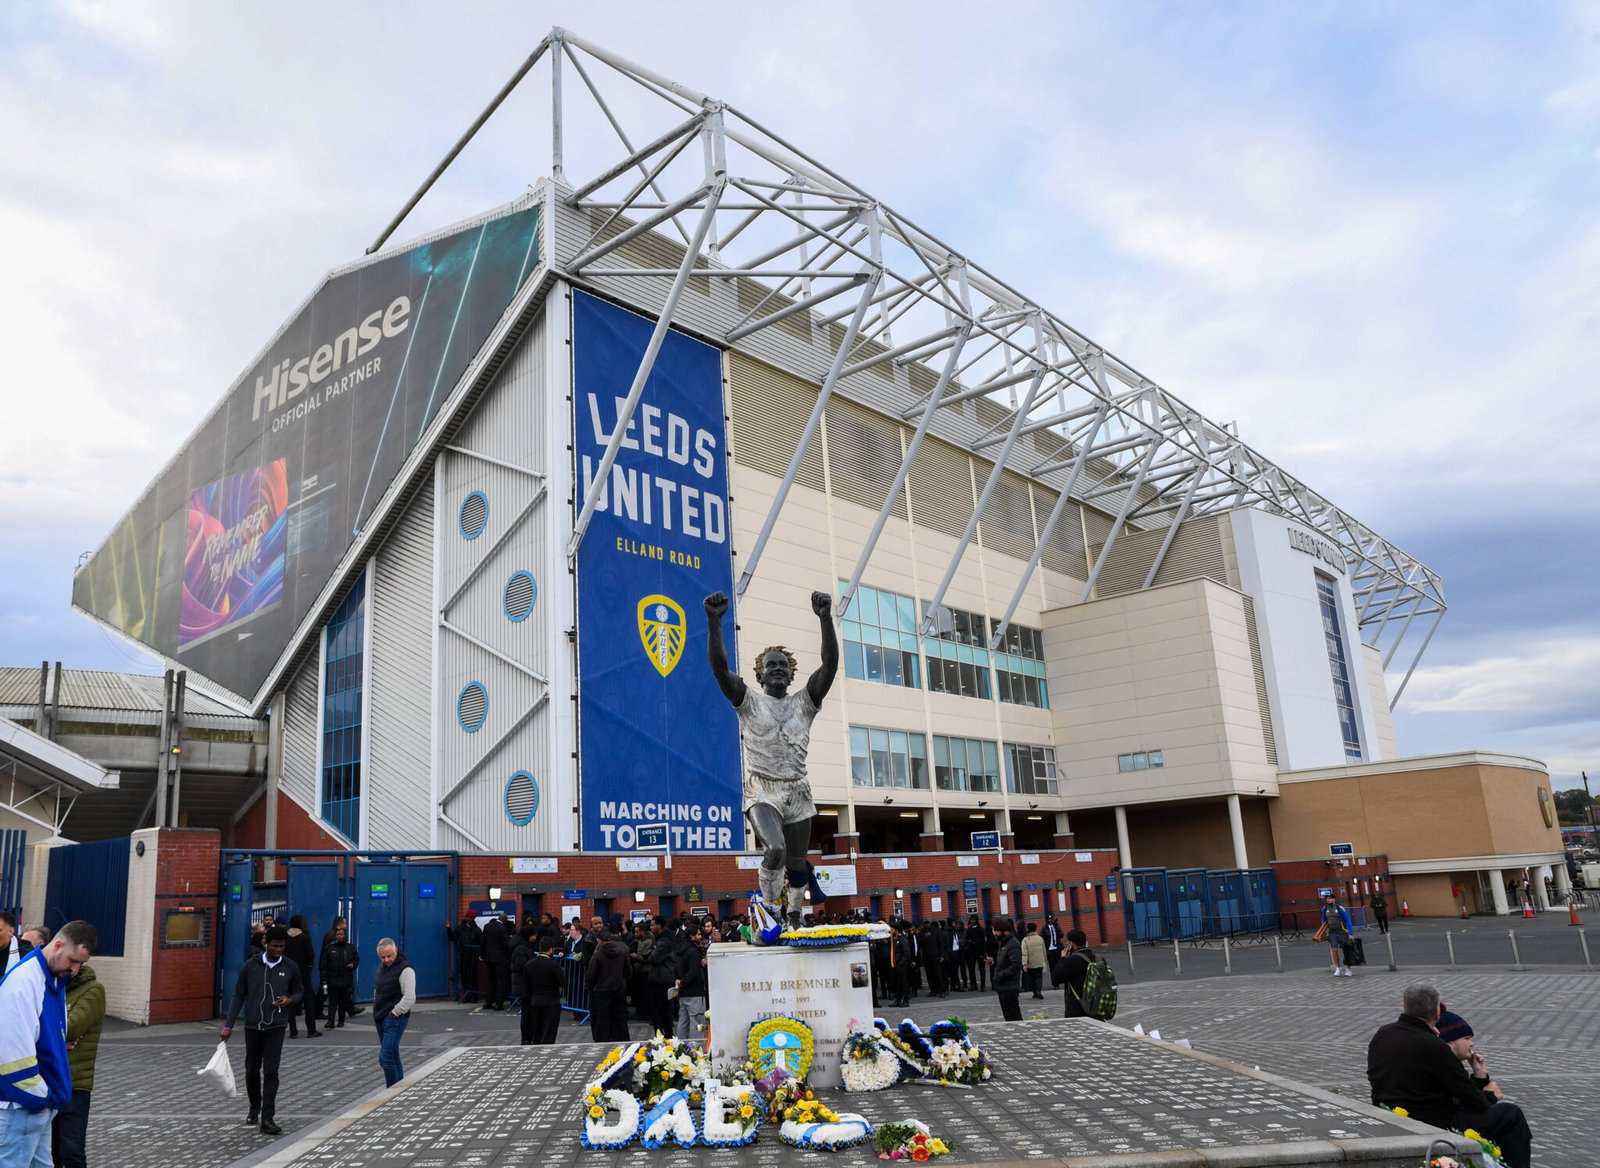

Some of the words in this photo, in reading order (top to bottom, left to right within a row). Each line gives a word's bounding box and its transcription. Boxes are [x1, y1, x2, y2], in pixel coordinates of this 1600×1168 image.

[252, 296, 410, 421] Hisense
[272, 393, 321, 432] OFFICIAL
[326, 357, 381, 401] PARTNER
[588, 393, 716, 478] LEEDS
[582, 455, 725, 544] UNITED
[617, 537, 663, 560] ELLAND
[670, 551, 700, 569] ROAD
[600, 801, 701, 821] MARCHING
[707, 805, 732, 822] ON
[600, 824, 732, 849] TOTHER
[649, 835, 657, 844] 13
[741, 981, 772, 992] BILLY
[780, 978, 840, 990] BREMNER
[790, 1009, 827, 1018] UNITED
